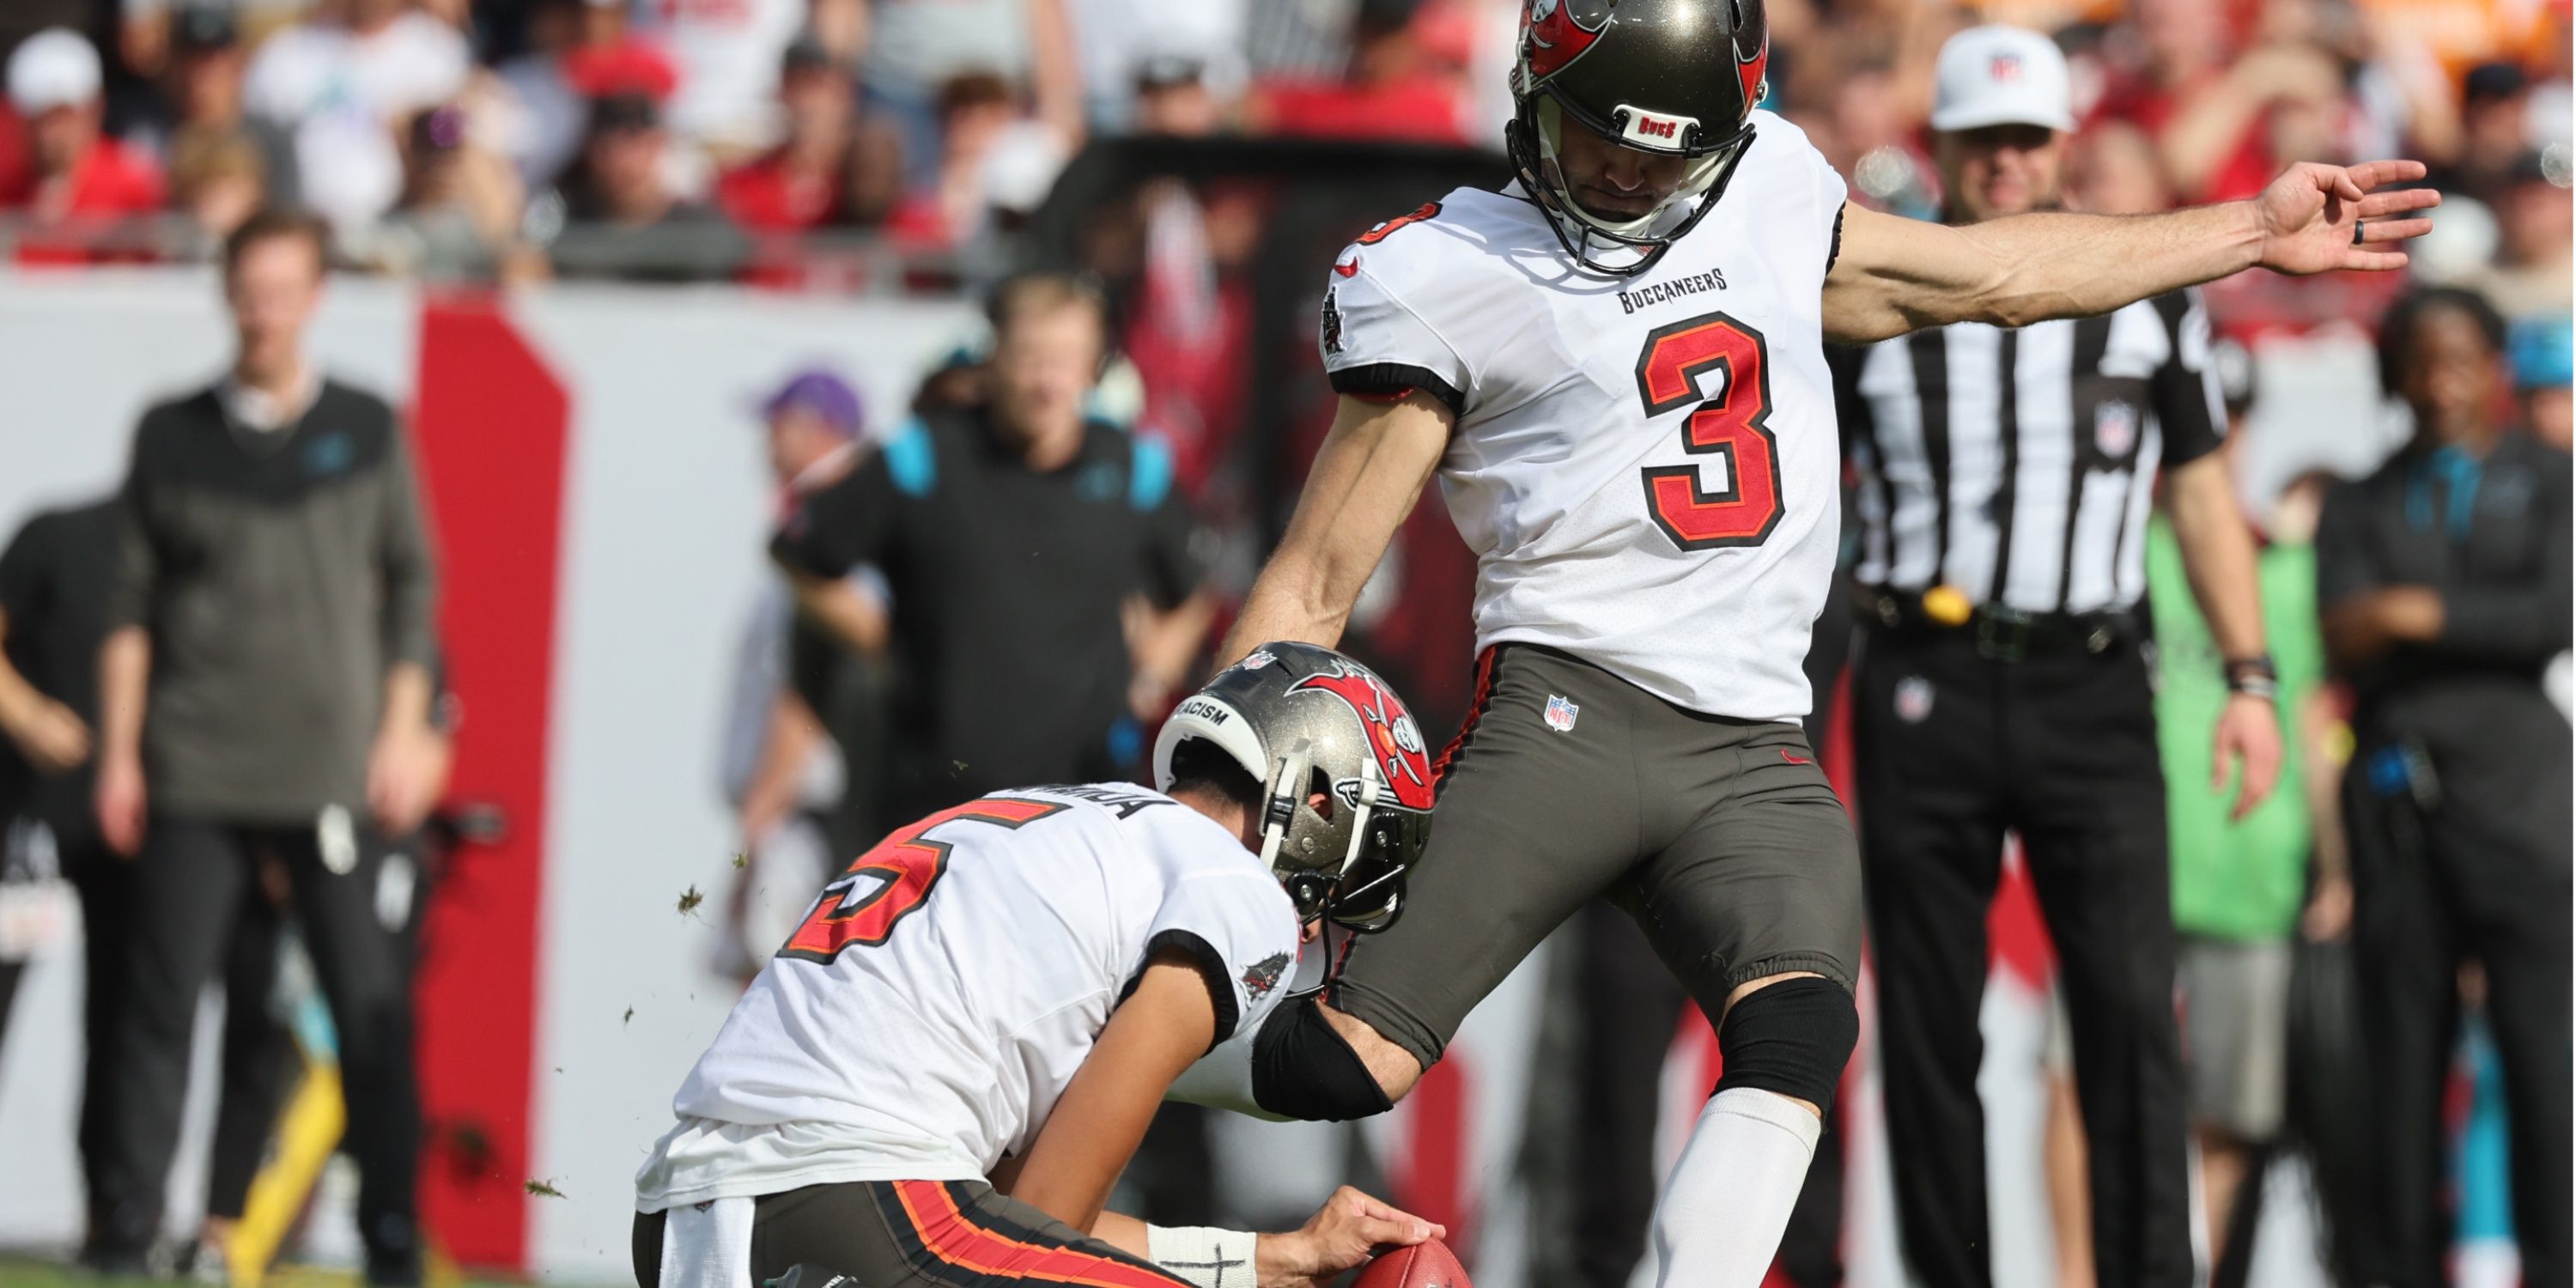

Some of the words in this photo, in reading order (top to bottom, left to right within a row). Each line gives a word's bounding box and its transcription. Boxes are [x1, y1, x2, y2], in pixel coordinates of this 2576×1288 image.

[1616, 267, 1728, 315] BUCCANEERS
[1634, 310, 1786, 552] 3
[775, 797, 1073, 965] 5
